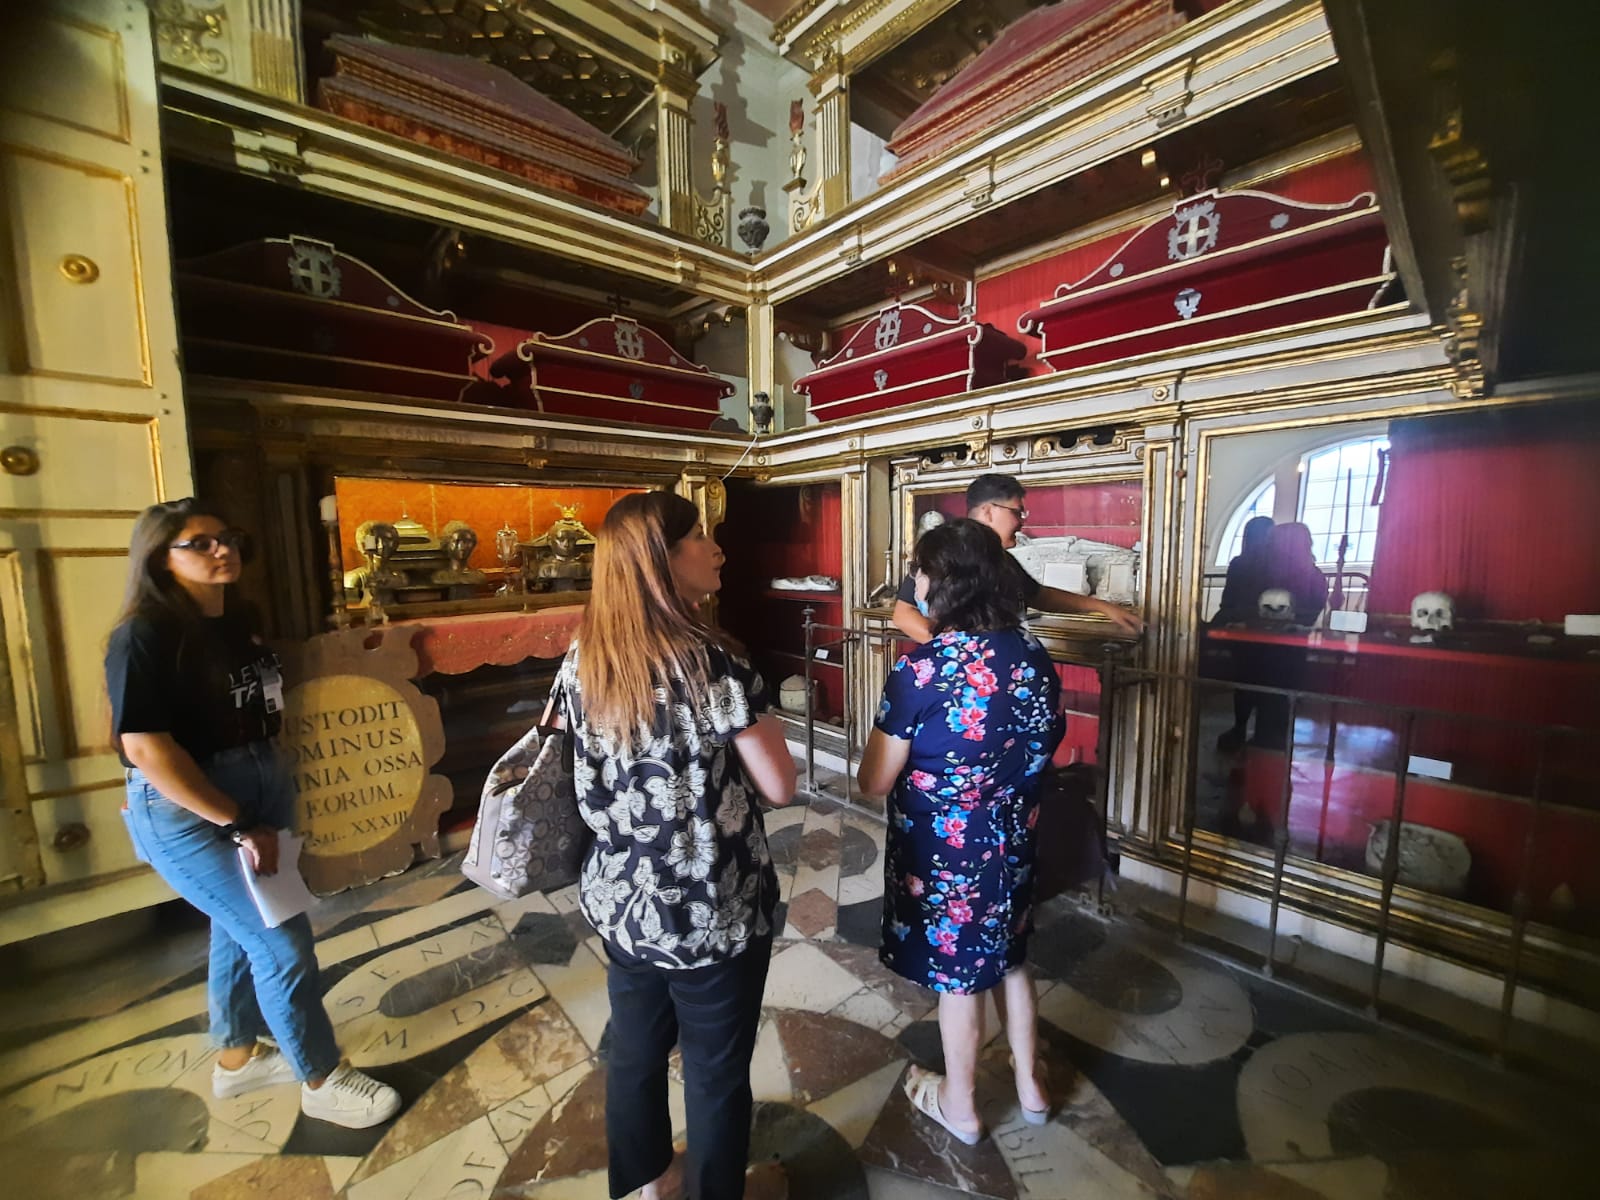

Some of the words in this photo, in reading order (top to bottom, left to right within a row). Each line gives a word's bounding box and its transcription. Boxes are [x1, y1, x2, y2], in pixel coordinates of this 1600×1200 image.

[284, 700, 404, 736] USTODIT
[363, 750, 423, 777] OSSA
[305, 782, 404, 820] EORUM.
